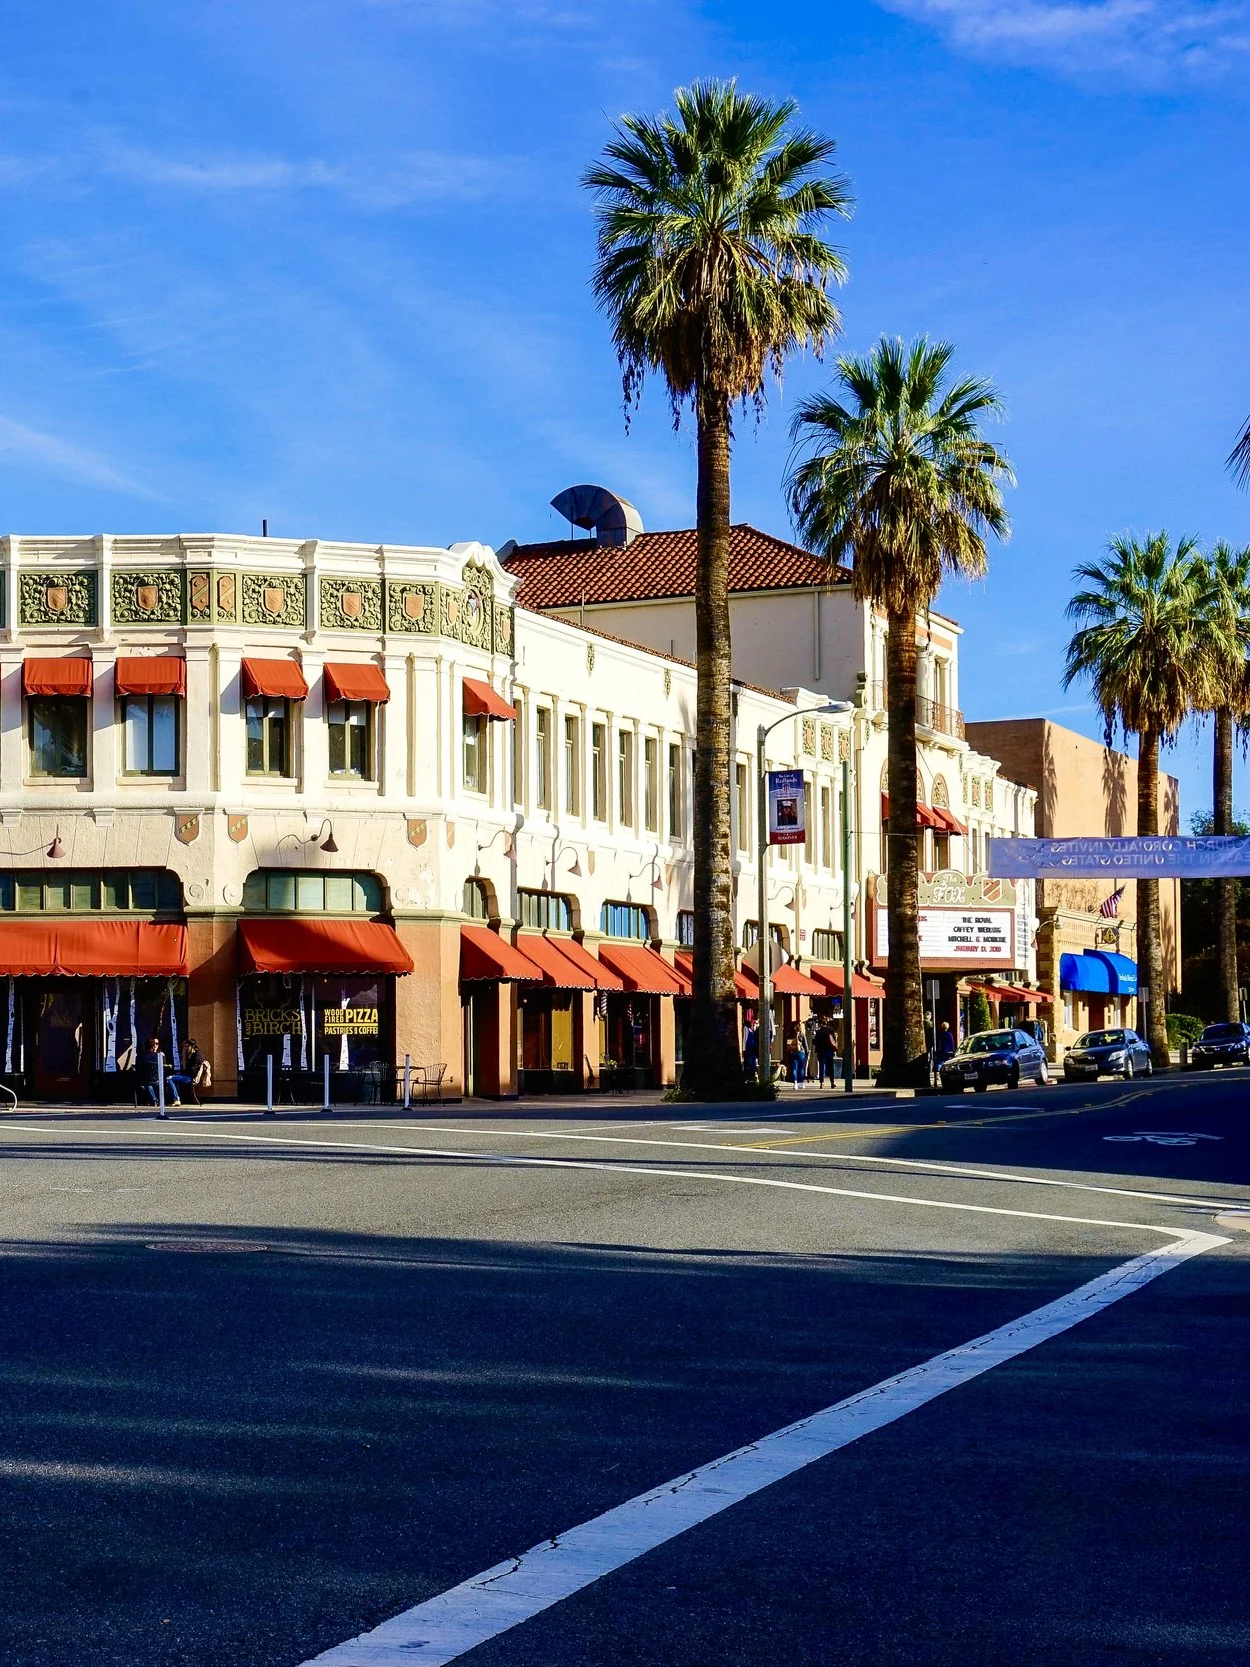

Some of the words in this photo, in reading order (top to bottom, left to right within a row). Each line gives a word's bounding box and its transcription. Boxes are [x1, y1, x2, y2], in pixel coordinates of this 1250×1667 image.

[933, 886, 965, 903] FOX
[245, 1009, 300, 1021] BRICKS
[345, 1009, 378, 1023] PIZZA
[252, 1021, 302, 1035] BIRCH
[324, 1027, 353, 1035] PASTRIES
